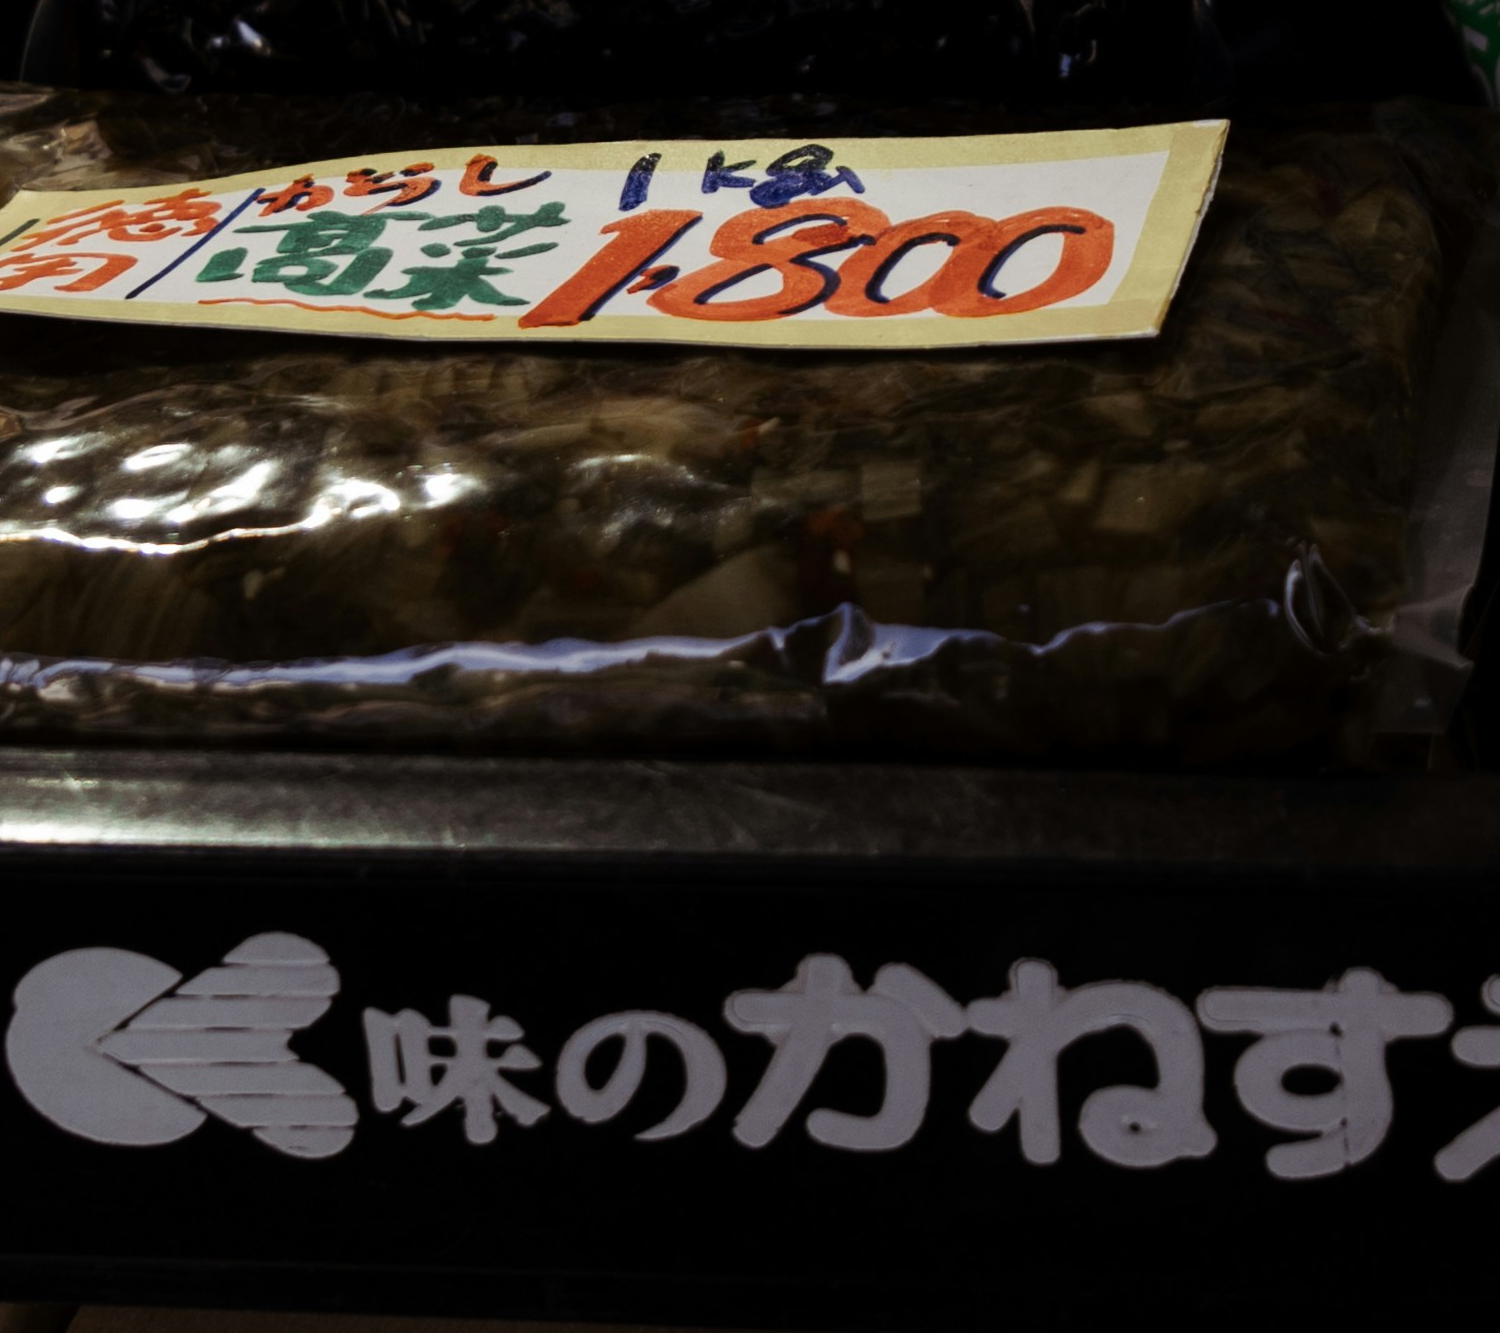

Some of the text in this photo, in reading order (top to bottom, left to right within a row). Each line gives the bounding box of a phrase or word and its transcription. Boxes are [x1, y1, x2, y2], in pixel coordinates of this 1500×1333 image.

[256, 153, 554, 217] からし
[196, 200, 571, 311] 高菜
